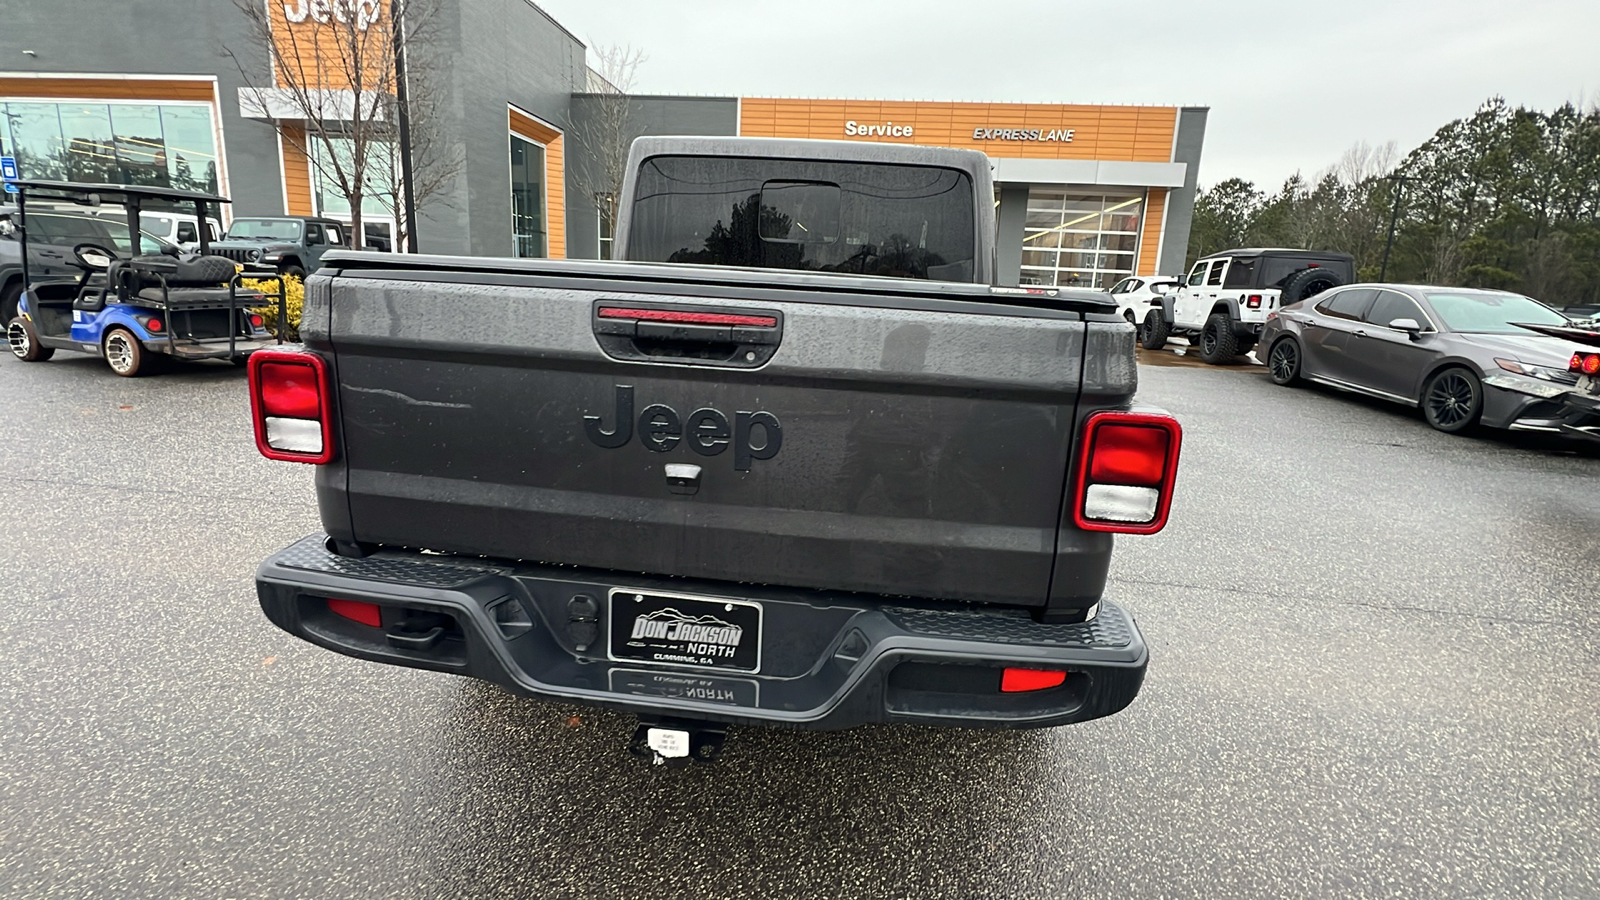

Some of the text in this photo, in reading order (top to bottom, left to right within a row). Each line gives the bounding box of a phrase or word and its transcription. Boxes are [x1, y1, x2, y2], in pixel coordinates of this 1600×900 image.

[284, 0, 380, 31] Jeep
[845, 120, 914, 137] Service
[972, 127, 1076, 142] EXPRESSLANE
[583, 384, 783, 471] Jeep
[687, 643, 736, 658] NORTH
[700, 657, 714, 665] GA
